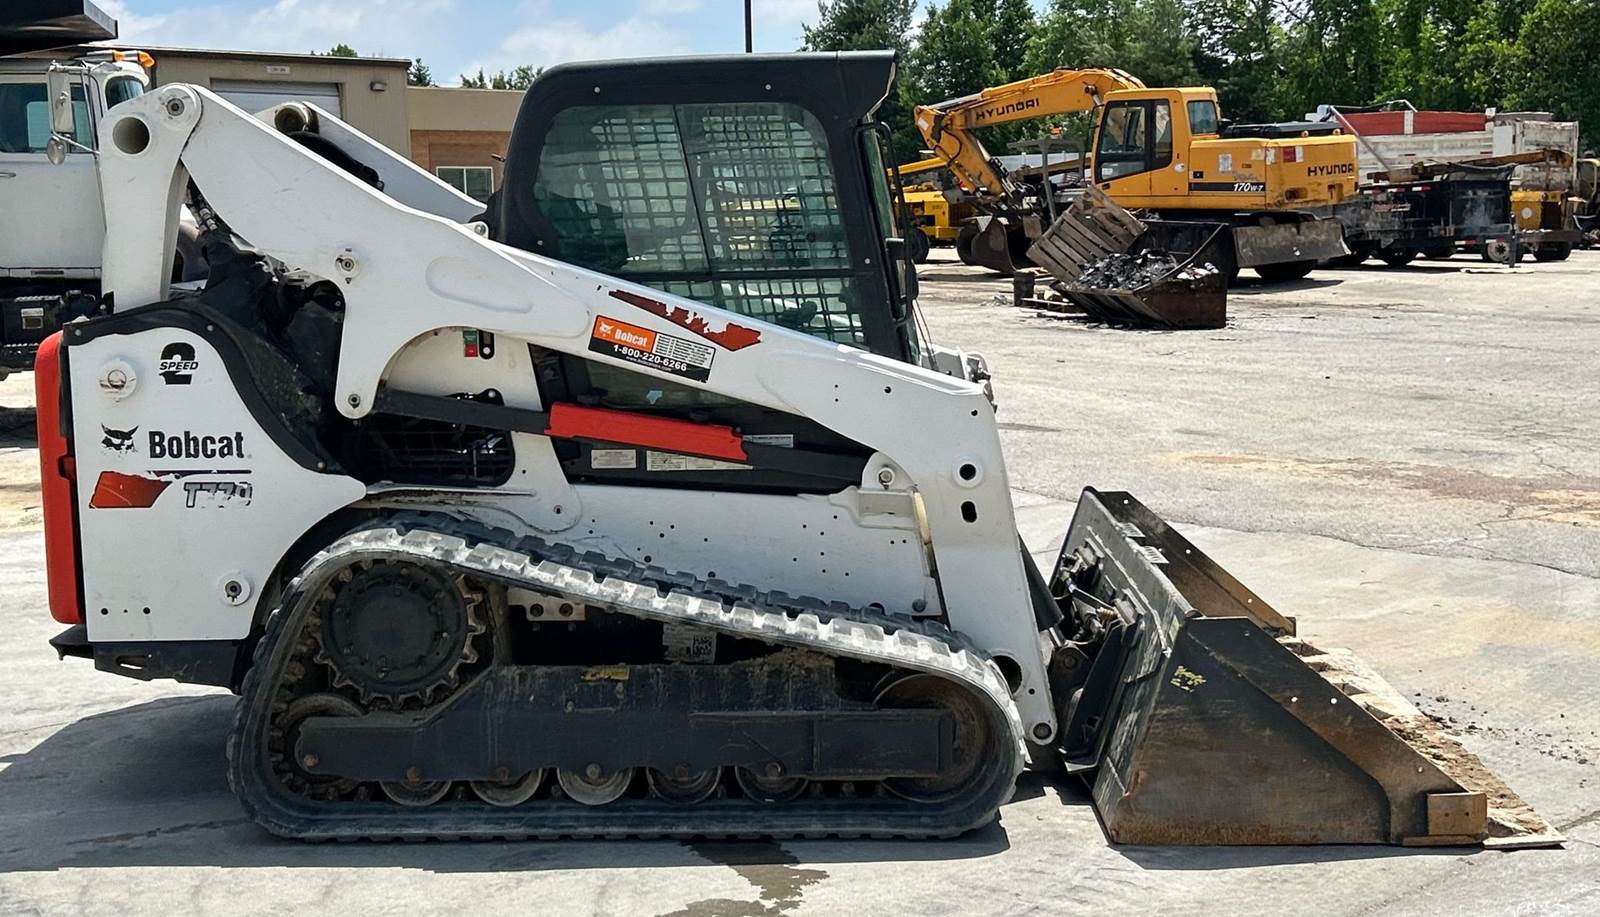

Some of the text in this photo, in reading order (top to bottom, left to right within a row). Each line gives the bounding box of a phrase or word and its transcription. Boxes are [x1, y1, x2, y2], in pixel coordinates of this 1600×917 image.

[975, 98, 1040, 120] HYUNDAI
[1307, 163, 1354, 176] HYUNDA
[614, 328, 648, 347] Bobcat
[159, 342, 196, 385] 2
[159, 361, 199, 371] SPEED
[613, 344, 688, 372] 1-800-220-6266
[148, 430, 245, 459] Bobcat
